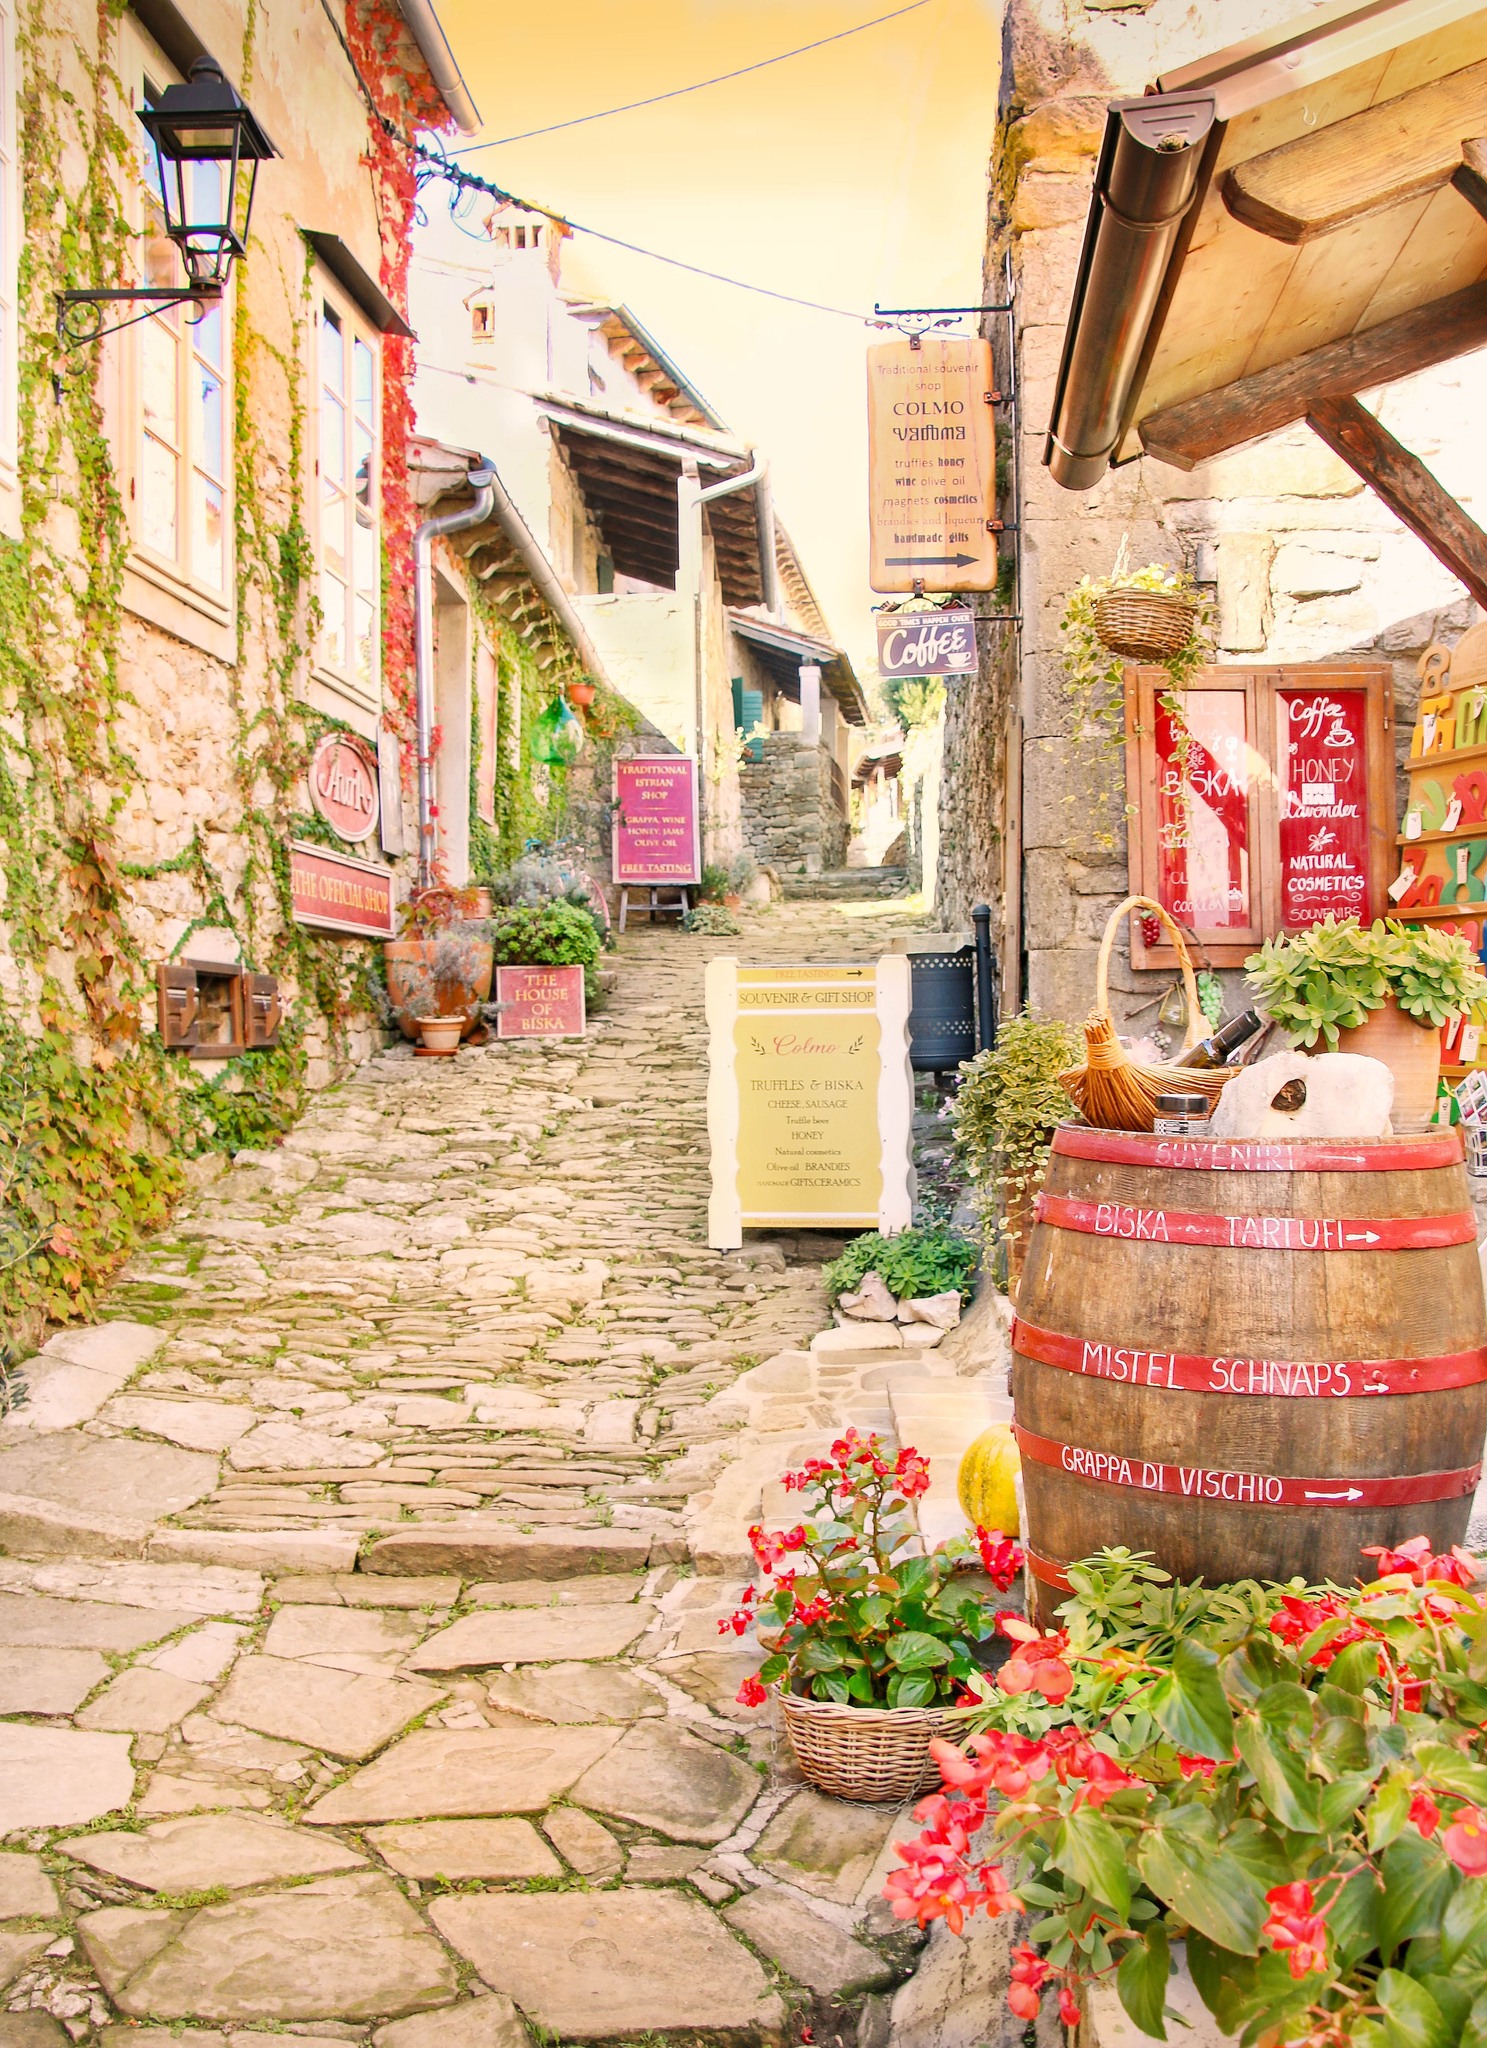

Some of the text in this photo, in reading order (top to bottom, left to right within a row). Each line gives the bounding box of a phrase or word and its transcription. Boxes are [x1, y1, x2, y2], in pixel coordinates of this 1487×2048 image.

[877, 364, 979, 375] Traditional souvenir
[915, 382, 941, 391] shop
[893, 401, 964, 416] COLMO
[895, 457, 965, 468] truffles honey
[895, 476, 965, 486] wine olive oil
[883, 494, 978, 507] magnets cosmetics
[877, 512, 984, 526] brandies and liqueurs
[894, 532, 969, 543] handmade gifts
[922, 616, 949, 624] HAPPEN
[951, 614, 970, 622] OVER
[1289, 697, 1346, 737] Coffee
[620, 766, 688, 775] TRADITIONAL
[1293, 757, 1355, 783] HONEY
[635, 778, 674, 787] ISTRIAN
[641, 790, 669, 800] SHOP
[662, 816, 686, 824] WINE
[663, 828, 685, 836] JAMS
[634, 839, 678, 847] OLIVE OIL
[621, 863, 692, 872] FREE TASTING
[1290, 853, 1355, 872] NATURAL
[1287, 875, 1366, 893] COSMETICS
[291, 869, 388, 914] THE OFFICIAL SHOP
[1288, 906, 1363, 922] SOUVENIRS
[775, 969, 796, 979] FREE
[523, 974, 558, 987] THE
[515, 988, 569, 1002] HOUSE
[739, 991, 874, 1004] SOUVENIR & GIFT SHOP
[531, 1002, 553, 1015] OF
[521, 1016, 565, 1030] BISKA
[773, 1034, 838, 1056] Colmo
[751, 1079, 864, 1091] TRUFFLES & BISKA
[805, 1099, 848, 1109] SAUSAGE
[786, 1115, 830, 1124] Truffle beer
[791, 1131, 824, 1140] HONEY
[775, 1147, 842, 1156] Natural cosmetics
[1155, 1142, 1294, 1171] SUVENIRI
[766, 1162, 850, 1171] Olive oil BRANDIES
[1094, 1204, 1345, 1249] BISKA TARTUFI
[1081, 1343, 1352, 1397] MISTEL SCHNAPS
[1061, 1446, 1284, 1503] GRAPPA DI VISCHIO
